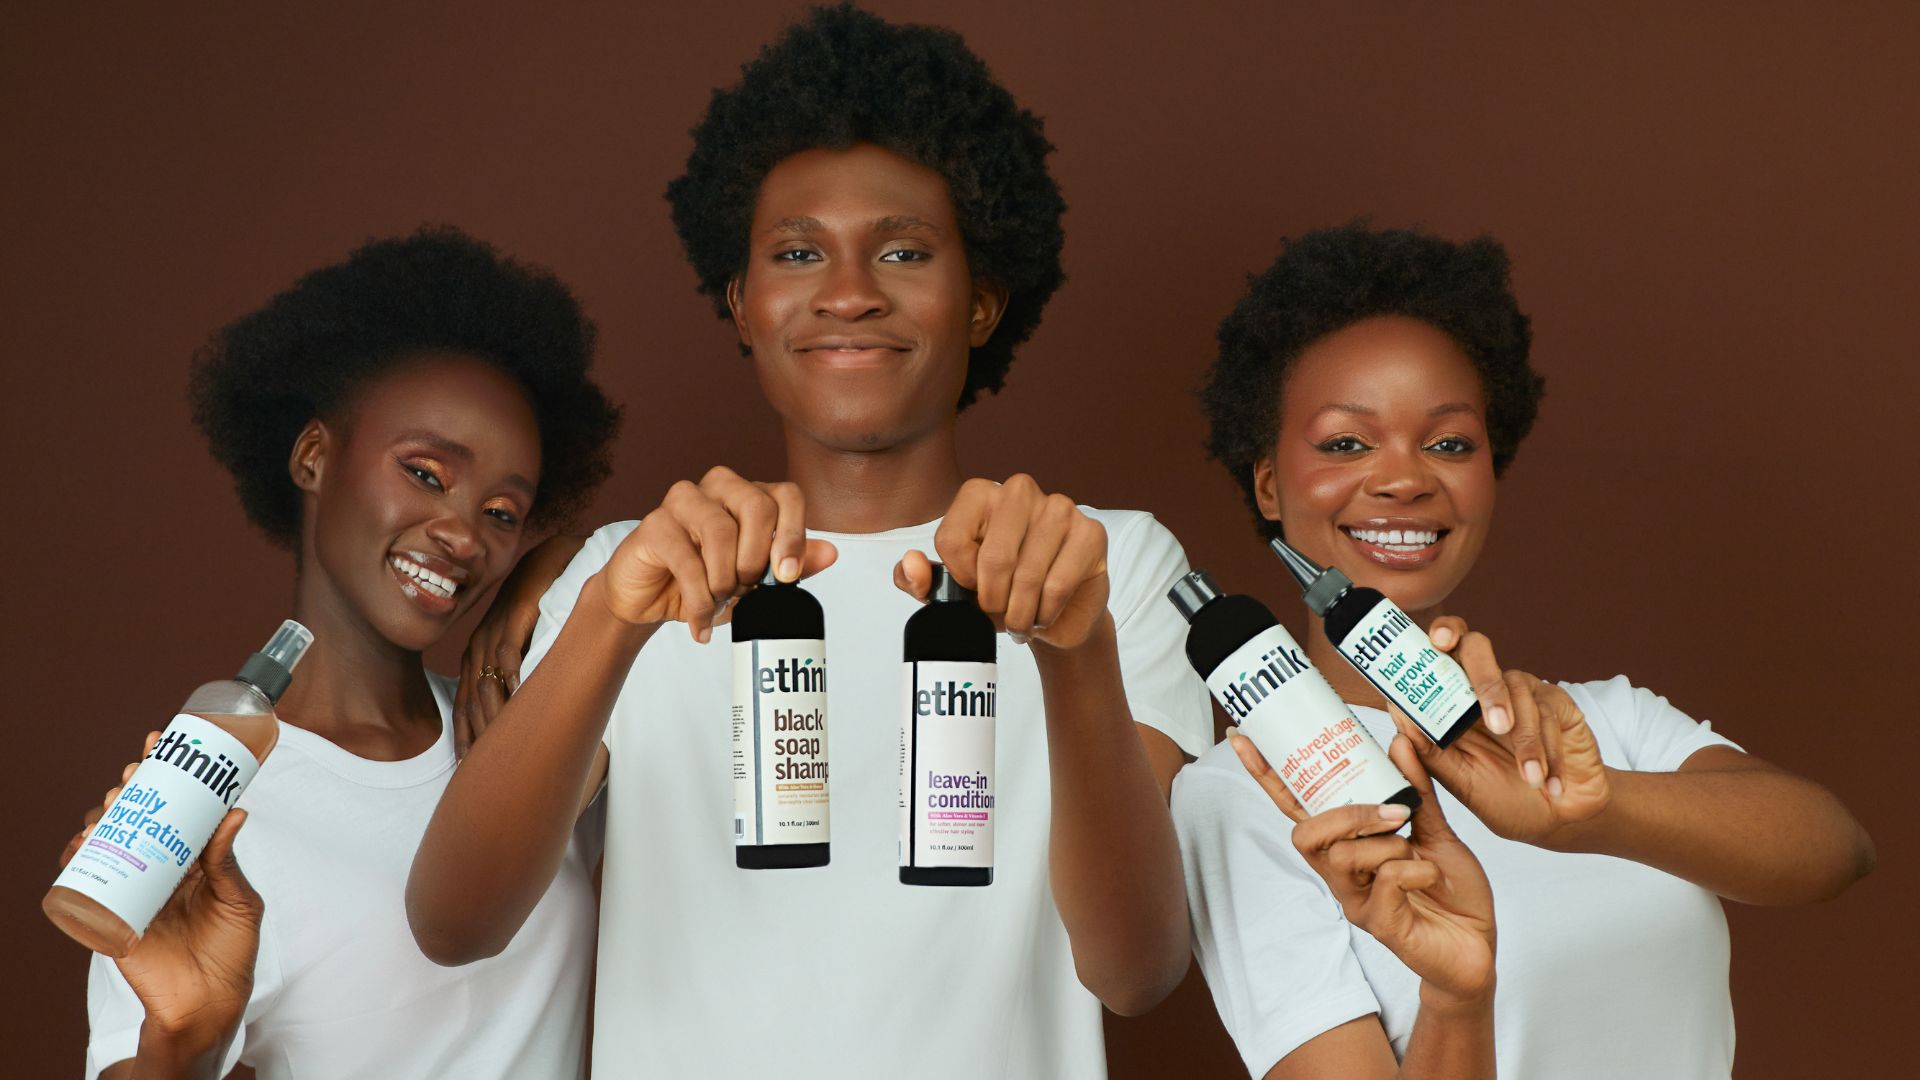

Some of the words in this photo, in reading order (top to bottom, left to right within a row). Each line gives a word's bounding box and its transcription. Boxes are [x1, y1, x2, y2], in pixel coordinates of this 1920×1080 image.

[1353, 608, 1413, 671] ethniik
[1378, 652, 1407, 681] hair
[1394, 648, 1438, 695] growth
[917, 681, 996, 717] ethnii
[1407, 671, 1438, 705] elixir
[774, 708, 823, 731] black
[774, 738, 820, 760] soap
[1281, 717, 1356, 779] anti-breakage
[1291, 760, 1323, 793] butter
[1322, 733, 1363, 764] lotion
[928, 770, 987, 789] leave-in
[121, 784, 167, 815] daily
[928, 790, 995, 808] condition
[95, 822, 138, 849] mist
[107, 801, 192, 867] hydrating
